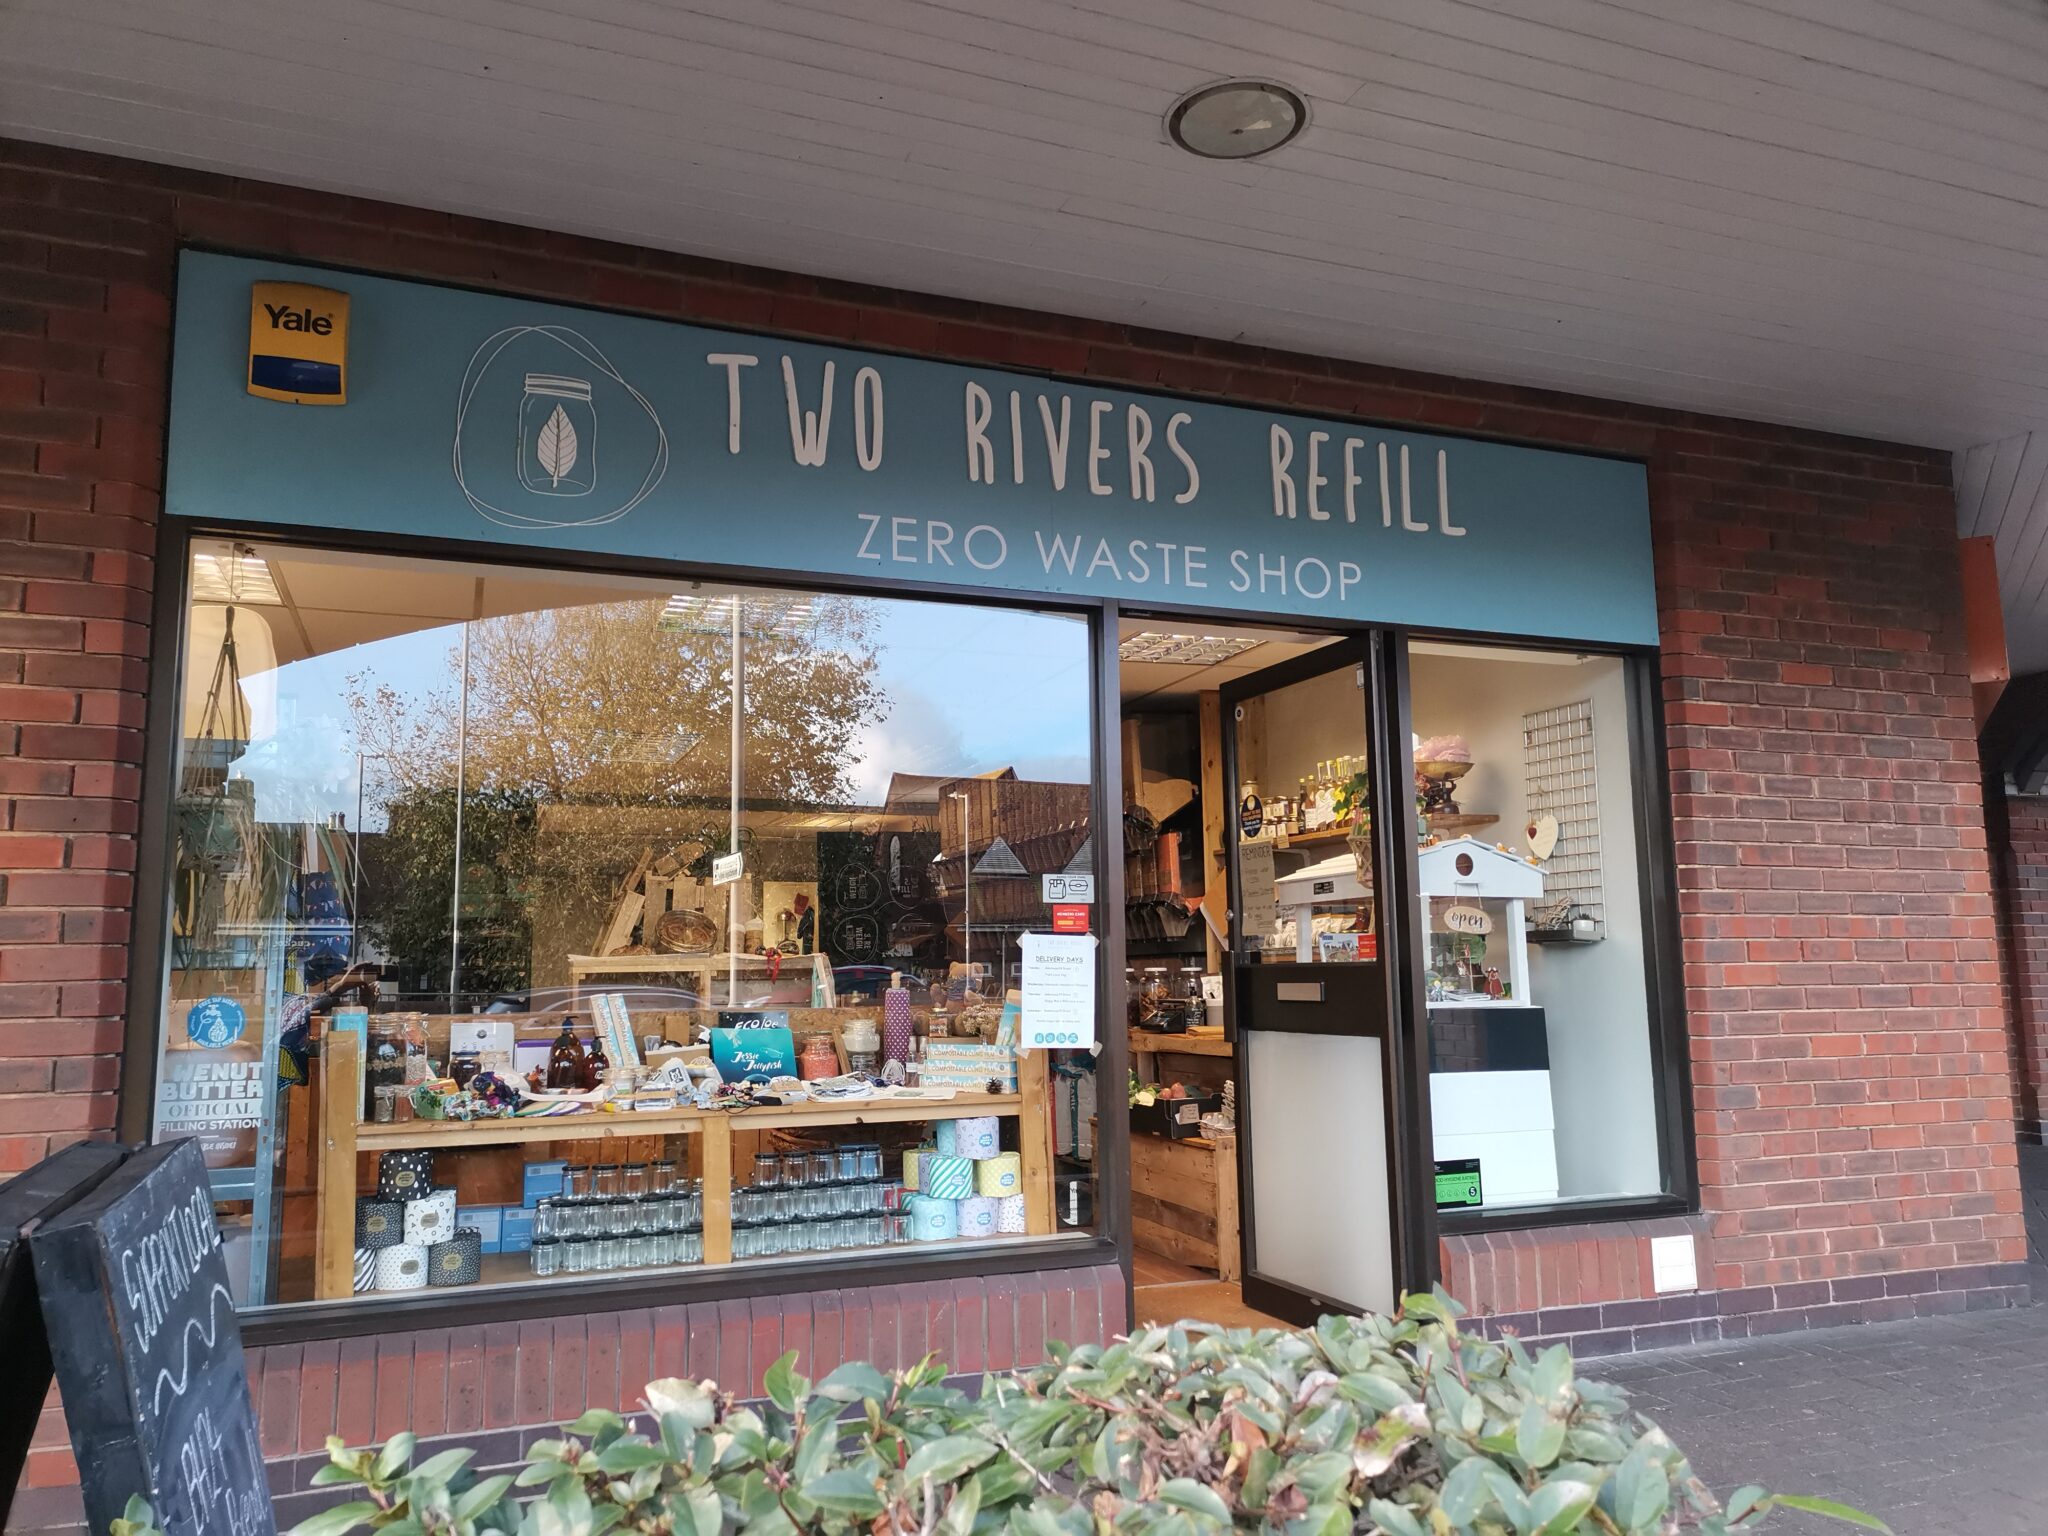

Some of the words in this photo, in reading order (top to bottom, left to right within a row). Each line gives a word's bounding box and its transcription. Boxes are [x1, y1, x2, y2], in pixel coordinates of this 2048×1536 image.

[263, 303, 332, 337] Yale
[706, 352, 884, 472] TWO
[965, 380, 1201, 505] RIVERS
[1269, 422, 1468, 538] REFILL
[855, 513, 1008, 571] ZERO
[1033, 530, 1209, 589] WASTE
[1229, 549, 1363, 602] SHOP
[1451, 912, 1483, 929] open
[1035, 955, 1065, 963] DELIVERY
[730, 1051, 760, 1063] Jessie
[743, 1060, 782, 1073] Jellyfish
[159, 1080, 264, 1101] BUTTER
[168, 1103, 254, 1118] OFFICIAL
[159, 1121, 207, 1133] FILLING
[208, 1119, 262, 1131] STATION
[121, 1205, 191, 1355] SUPPORT
